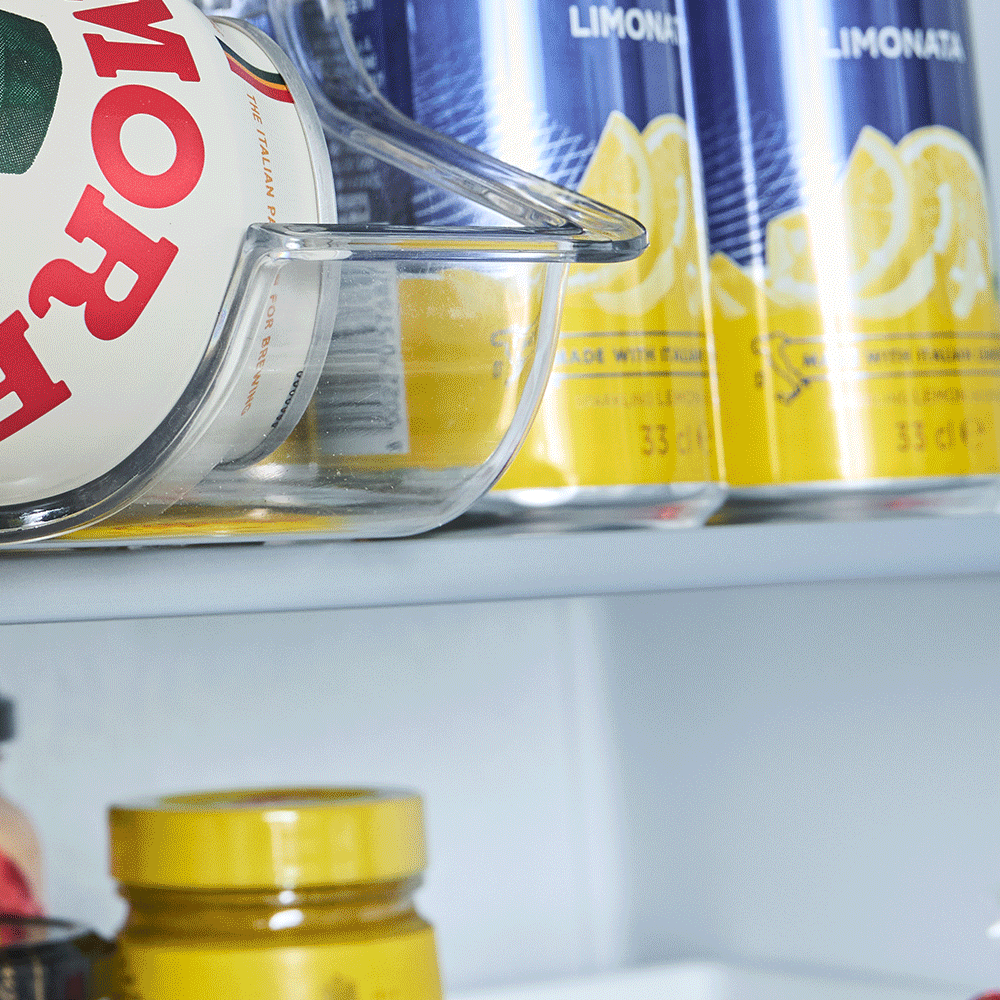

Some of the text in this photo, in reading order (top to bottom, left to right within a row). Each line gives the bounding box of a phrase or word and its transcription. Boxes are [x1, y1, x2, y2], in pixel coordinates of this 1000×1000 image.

[819, 24, 967, 64] LIMONATA
[246, 92, 263, 125] THE
[256, 128, 275, 198] ITALIAN
[263, 293, 278, 330] FOR
[240, 335, 272, 417] BREWING
[638, 424, 671, 456] 33
